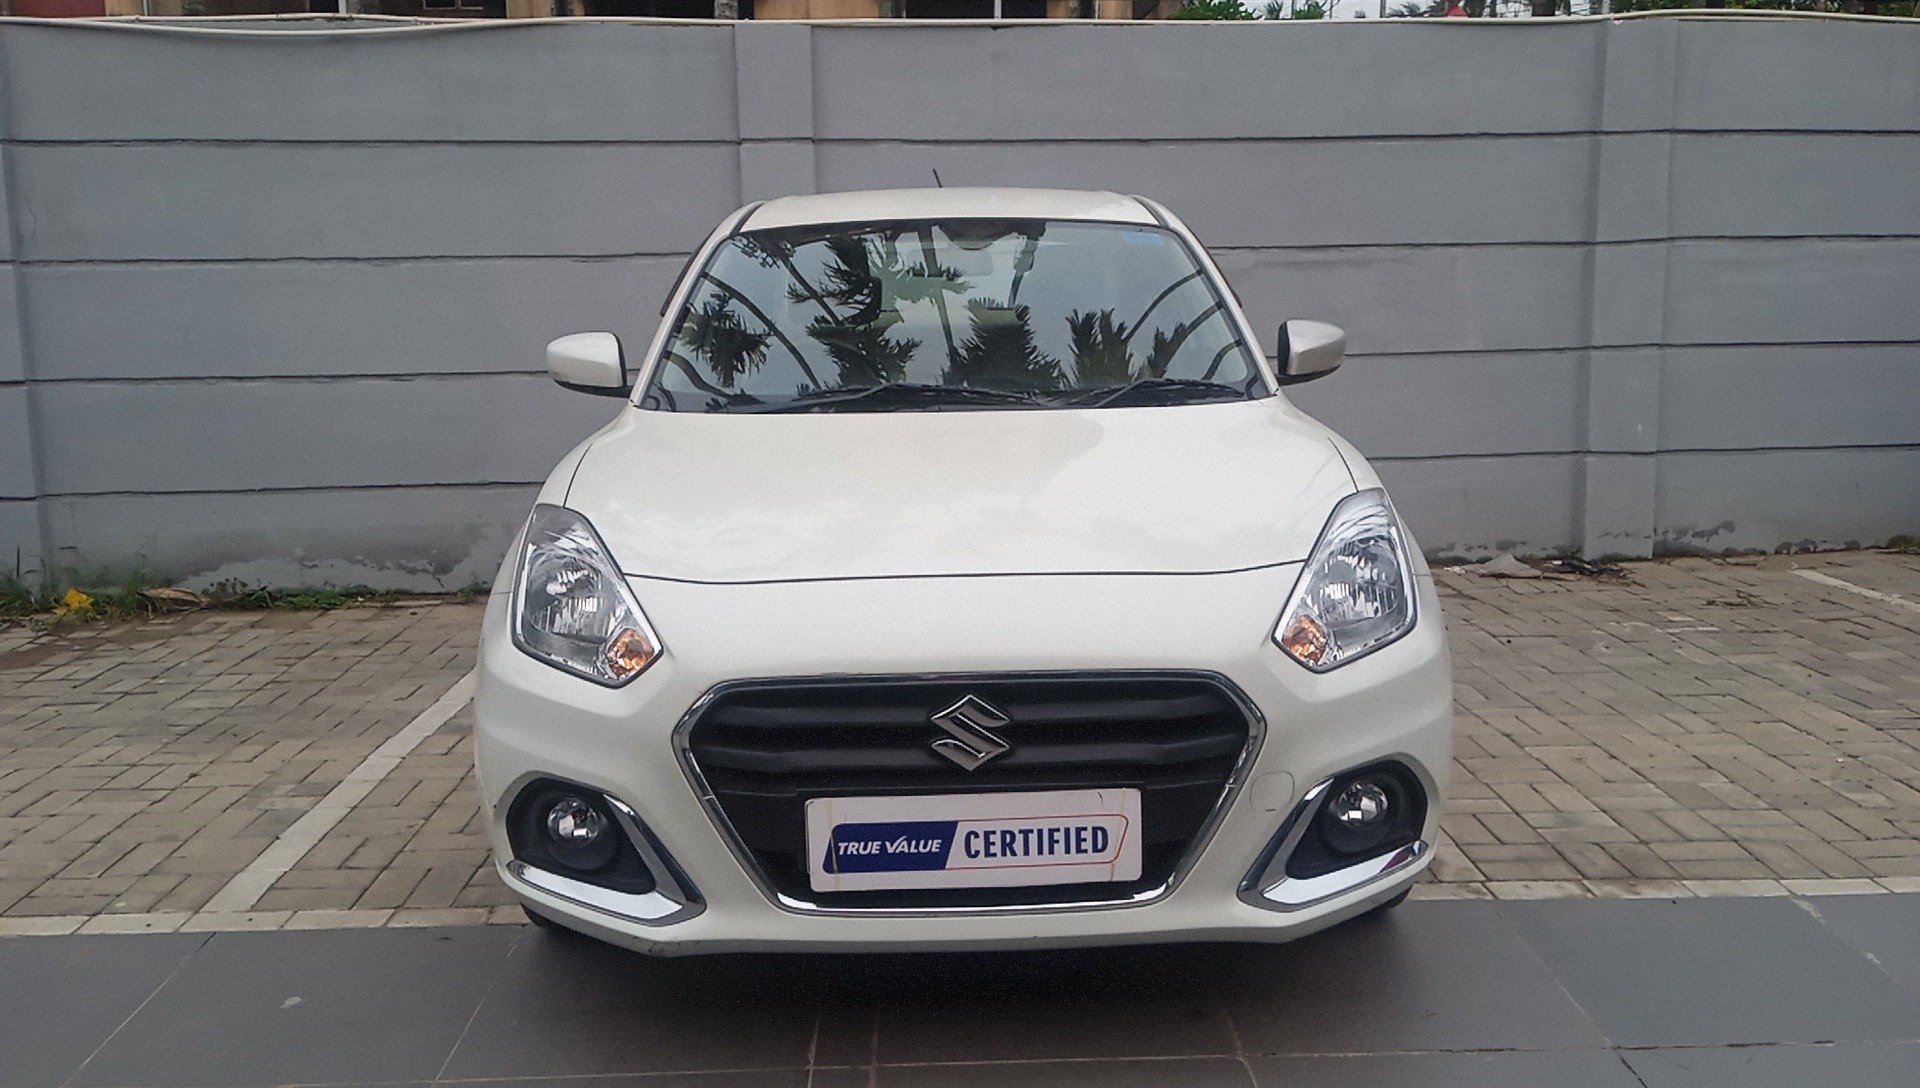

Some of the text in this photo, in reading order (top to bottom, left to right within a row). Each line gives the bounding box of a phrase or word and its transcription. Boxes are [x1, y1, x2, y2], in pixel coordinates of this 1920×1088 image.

[838, 826, 1109, 859] TRUE VALUE CERTIFIED
